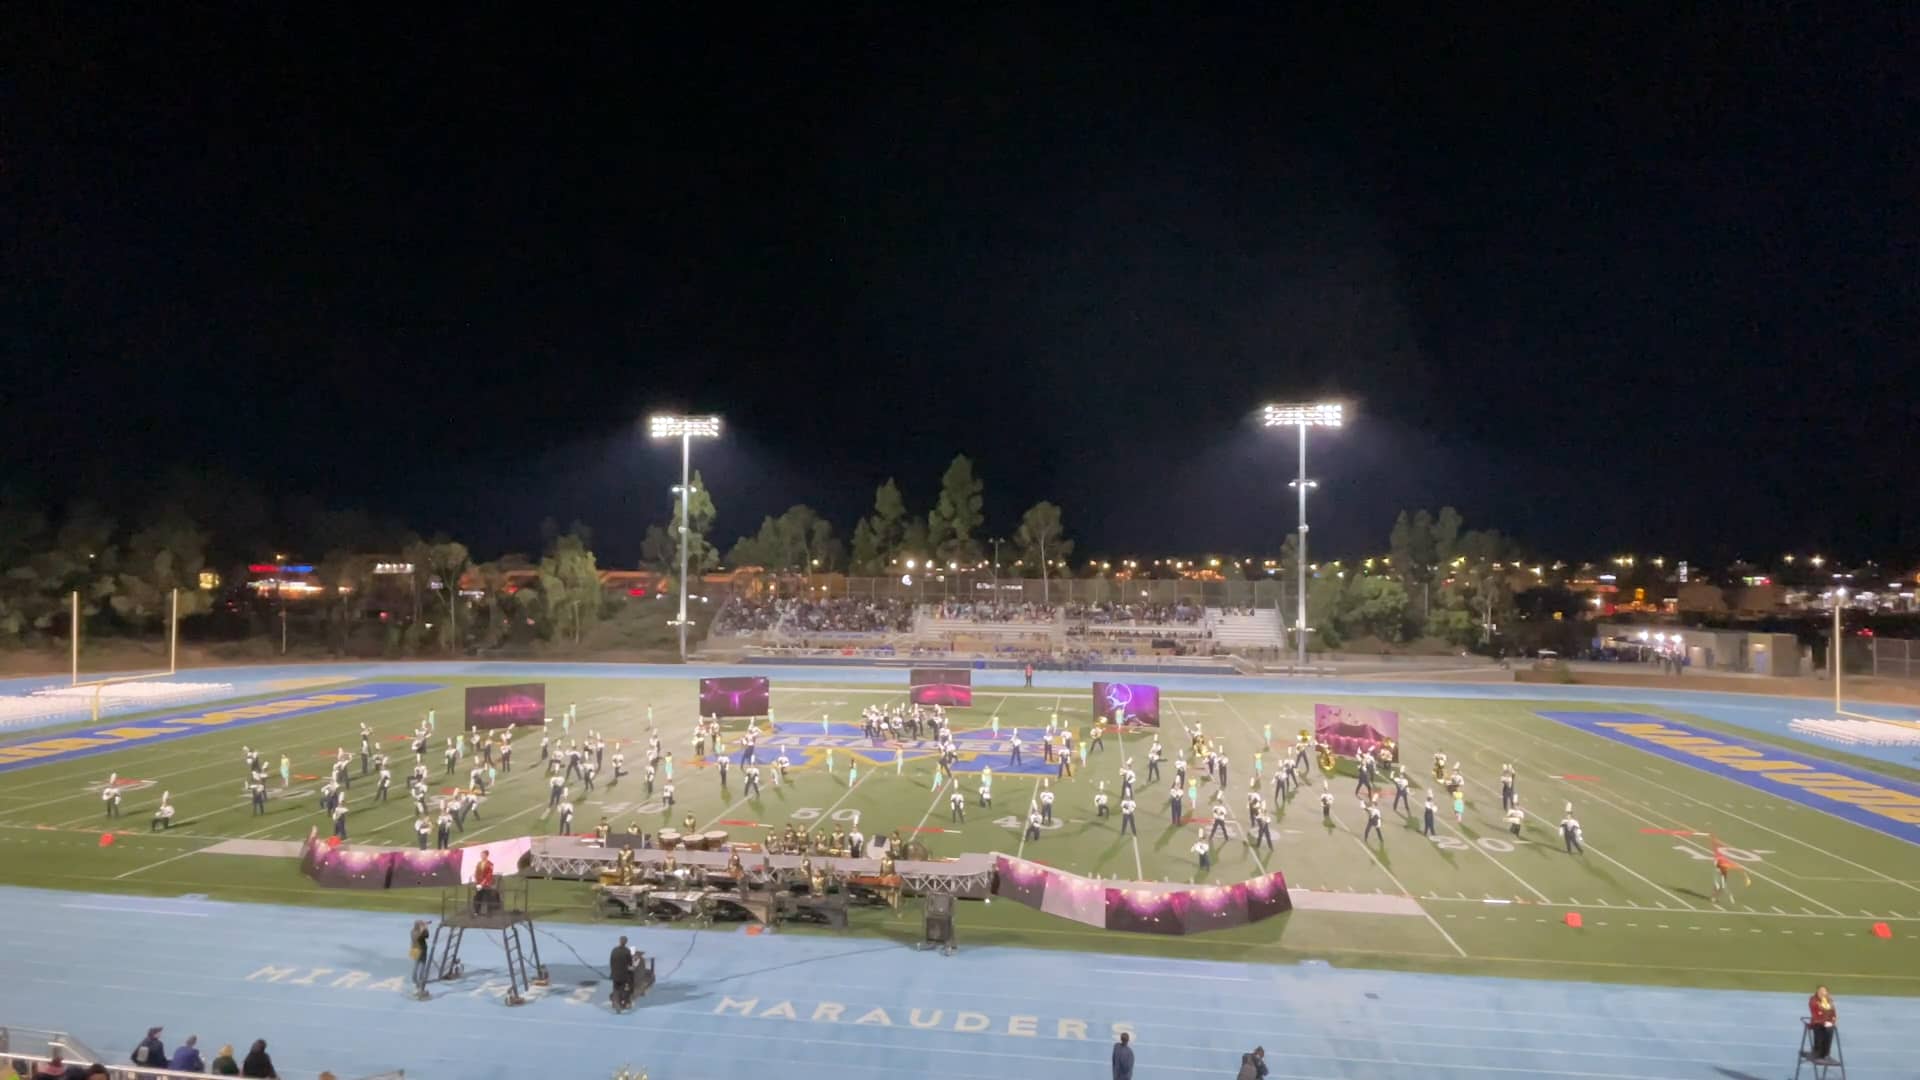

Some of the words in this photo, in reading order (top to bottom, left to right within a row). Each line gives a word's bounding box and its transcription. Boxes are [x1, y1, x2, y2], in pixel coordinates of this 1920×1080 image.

[791, 807, 861, 821] 50
[1427, 835, 1514, 853] 20
[1672, 845, 1762, 862] 10
[245, 965, 406, 992] MIRA
[713, 995, 1138, 1044] MARAUDERS
